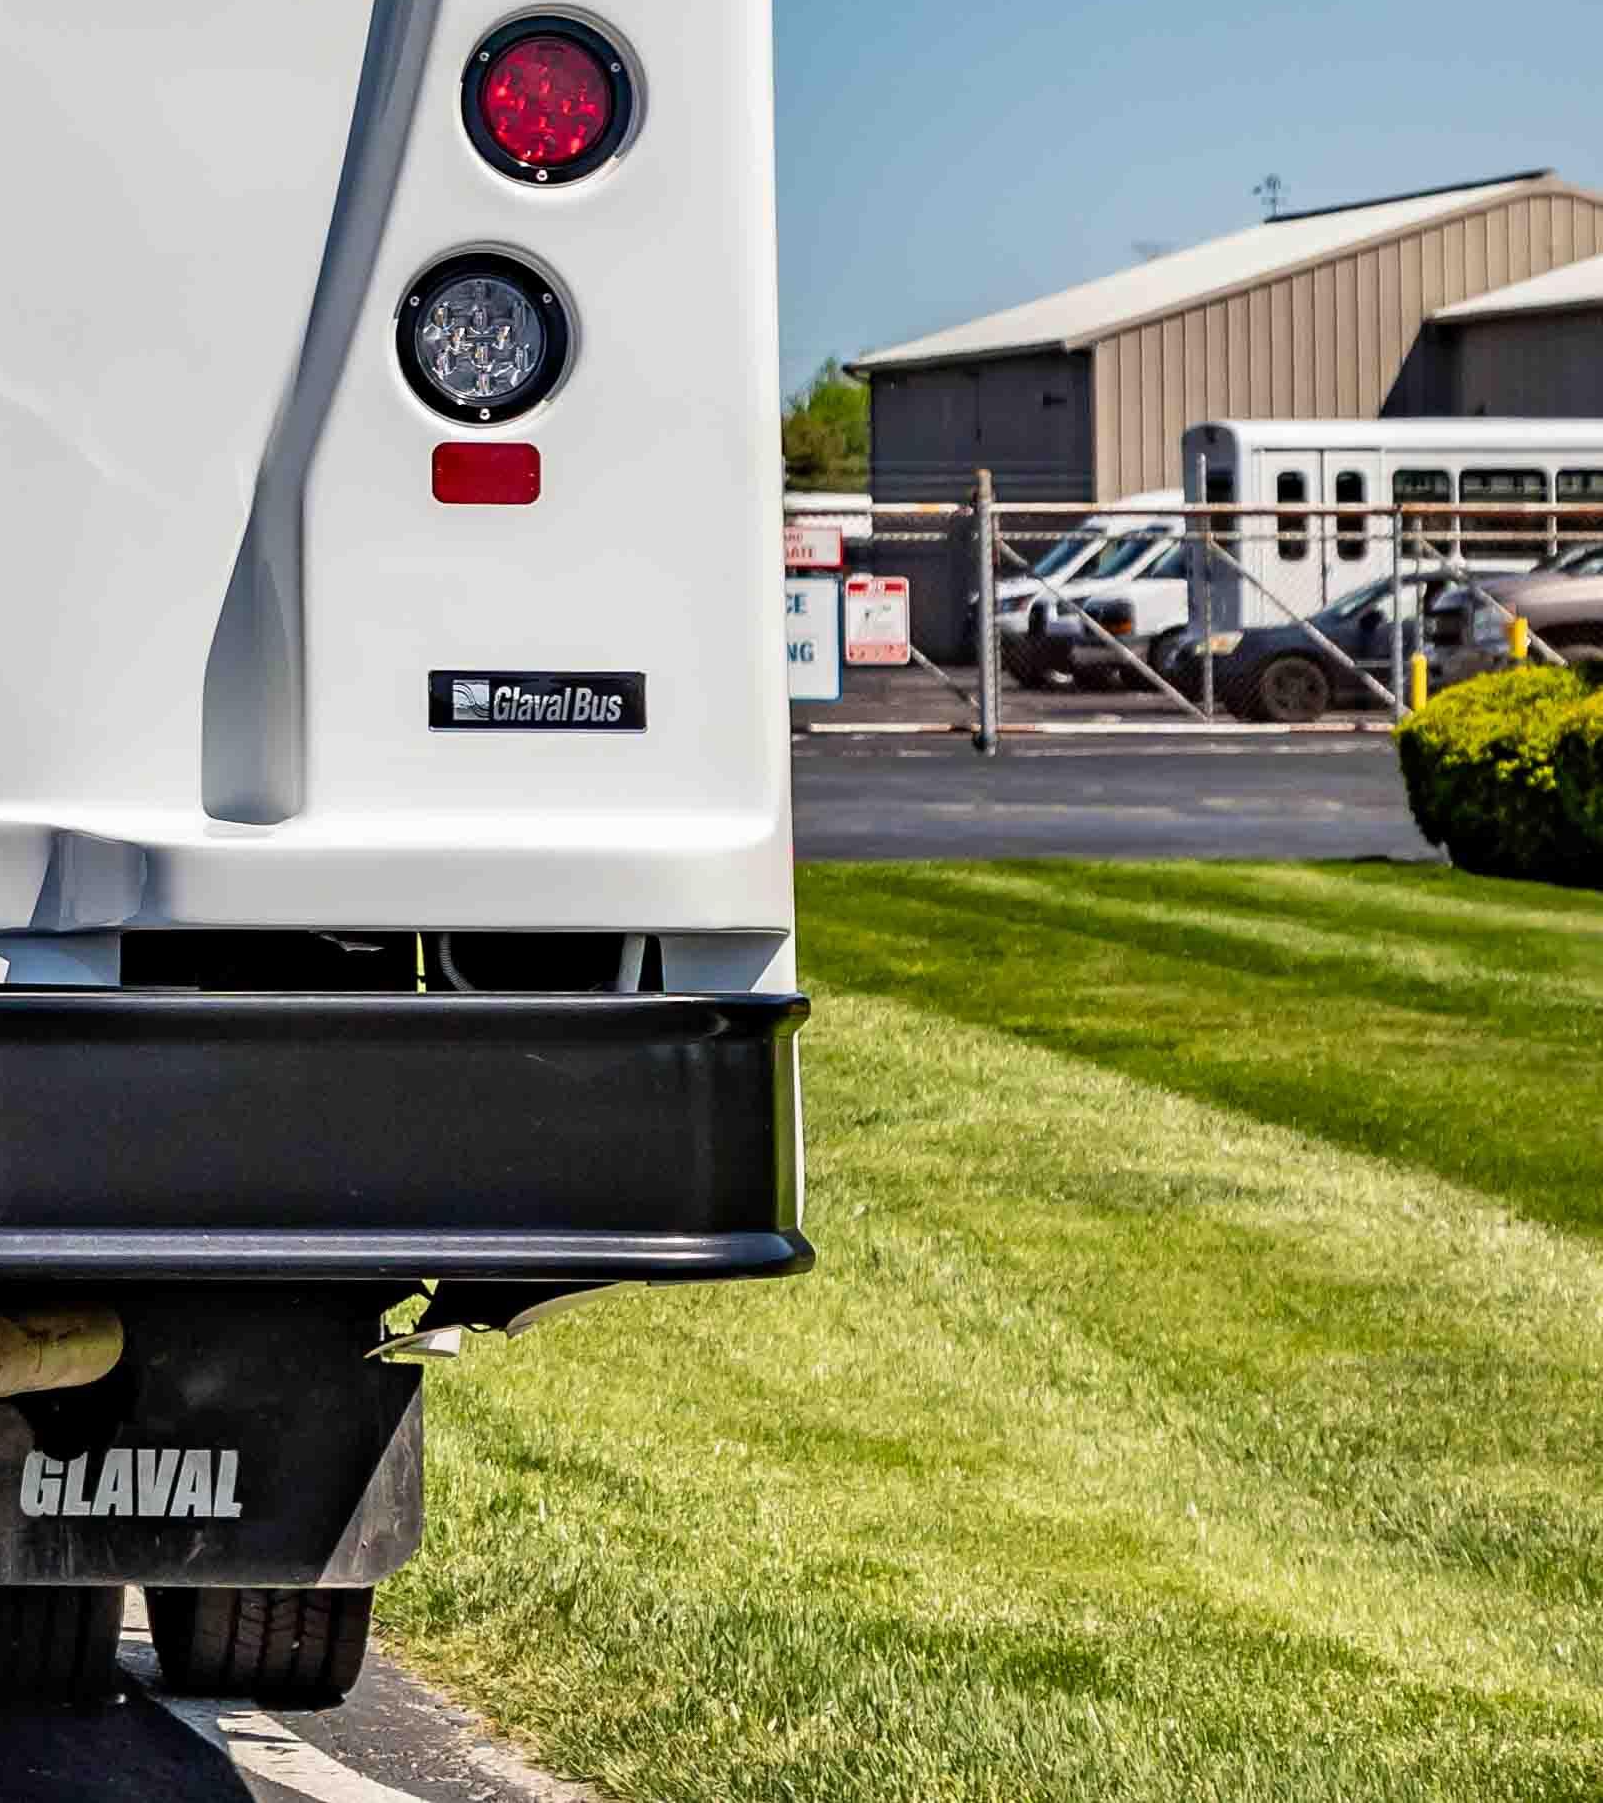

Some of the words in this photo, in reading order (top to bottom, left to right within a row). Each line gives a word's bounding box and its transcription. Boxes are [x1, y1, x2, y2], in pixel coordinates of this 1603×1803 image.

[786, 642, 814, 662] NG
[493, 686, 572, 722] Glaval
[572, 687, 624, 722] Bus
[19, 1448, 244, 1518] GLAVAL
